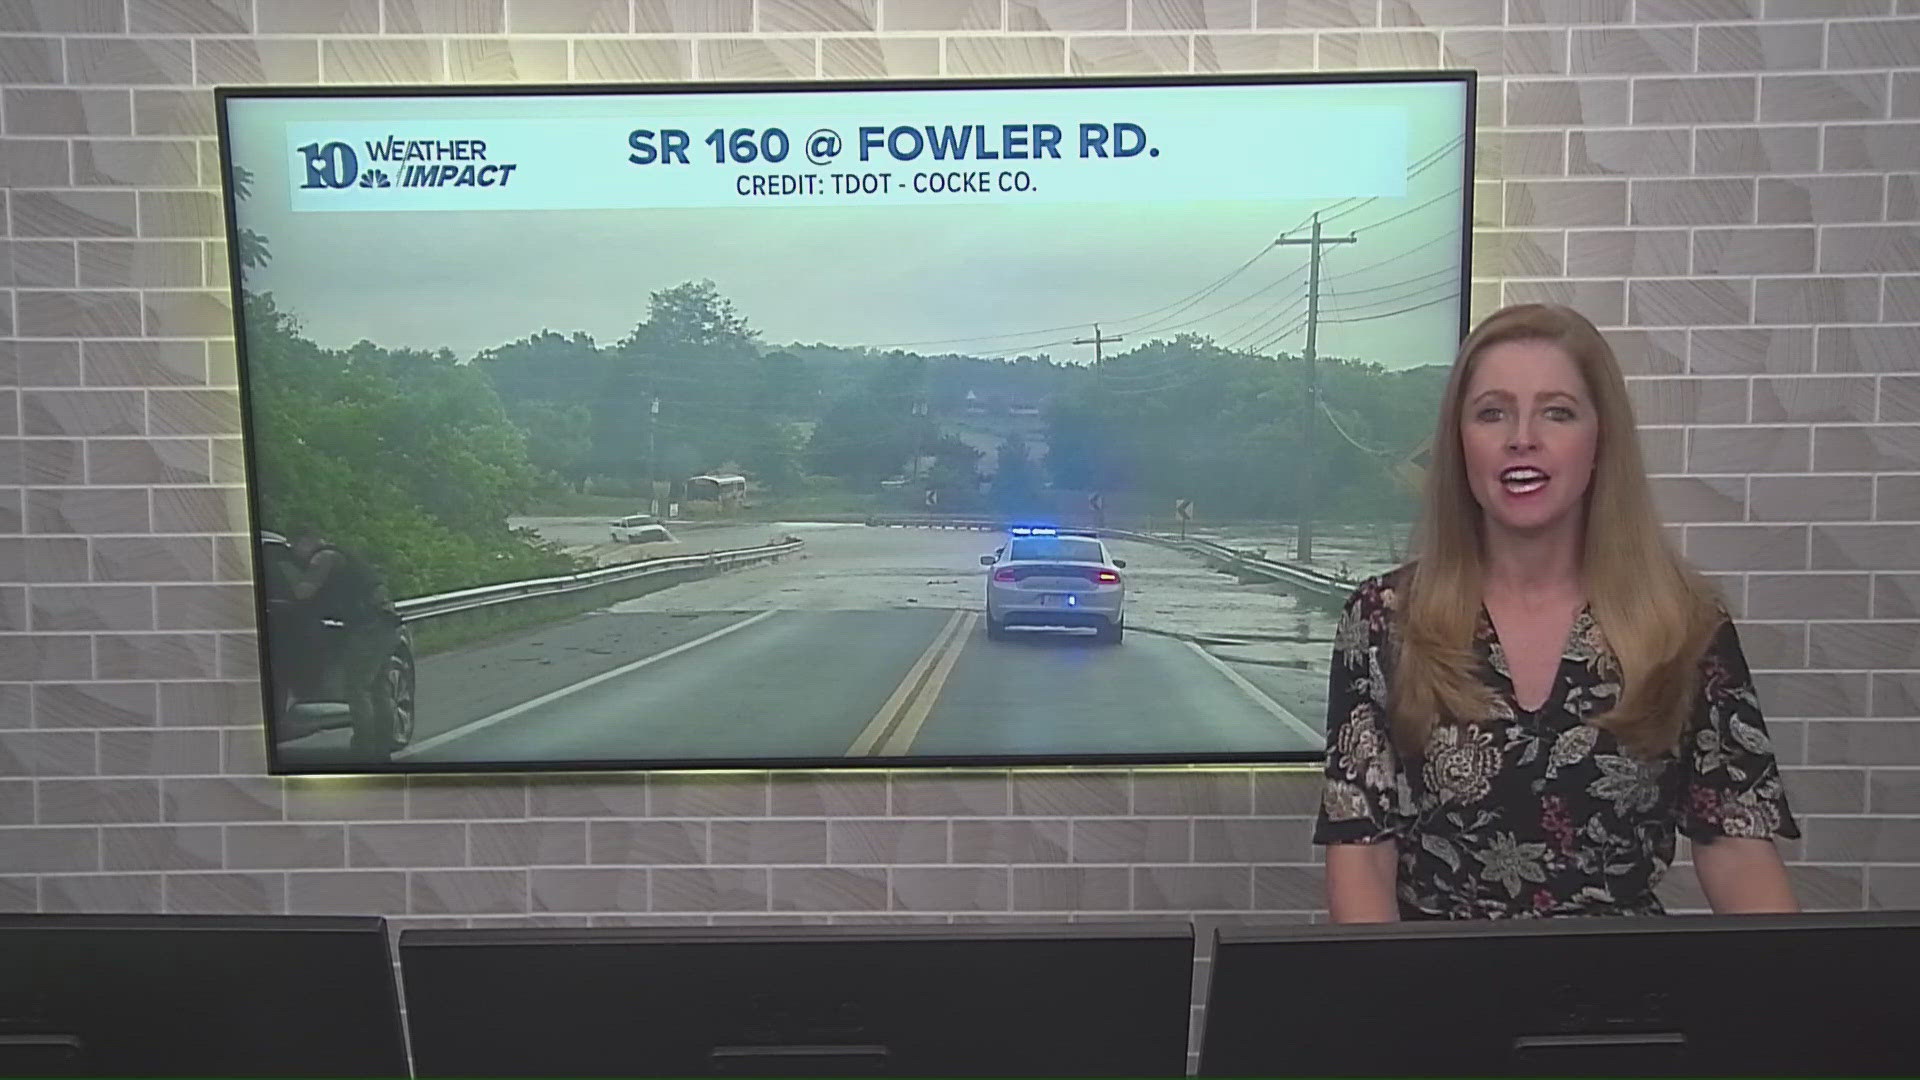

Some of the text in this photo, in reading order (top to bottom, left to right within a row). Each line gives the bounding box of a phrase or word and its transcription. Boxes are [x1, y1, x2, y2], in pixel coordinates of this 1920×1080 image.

[365, 135, 487, 161] WEATHER
[628, 122, 1160, 166] SR 160 @ FOWLER RD.
[297, 141, 358, 189] 10
[402, 164, 517, 188] IMPACT
[736, 174, 824, 196] CREDIT:
[831, 173, 892, 194] TDOT
[913, 171, 991, 193] COCKE
[998, 170, 1038, 193] CO.
